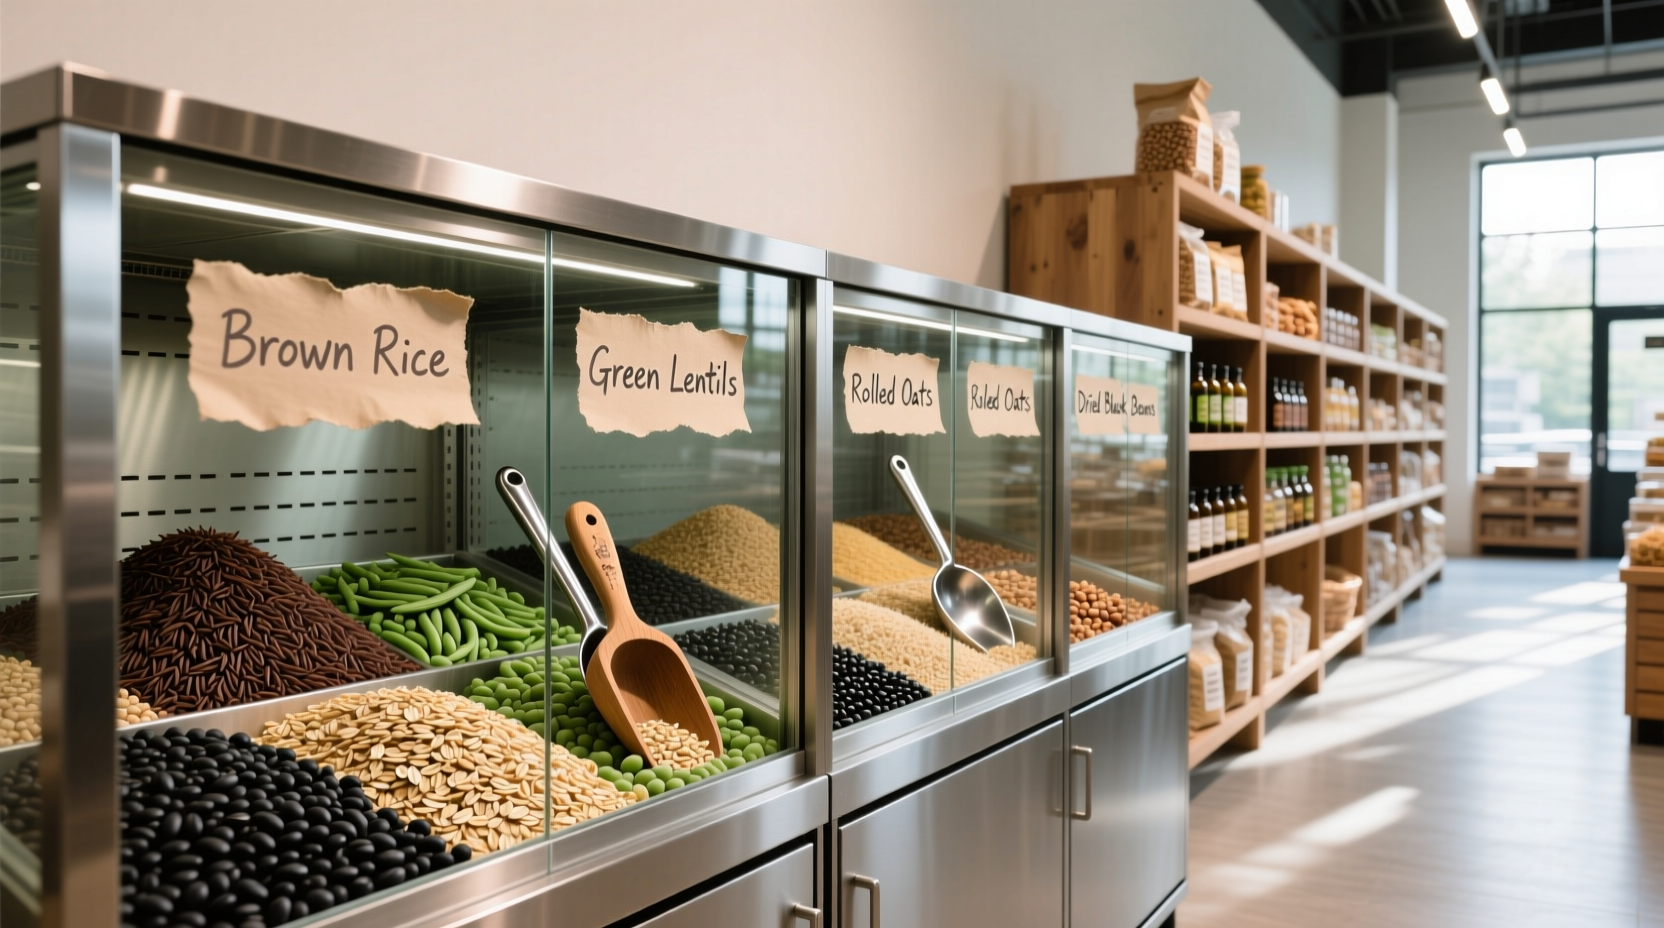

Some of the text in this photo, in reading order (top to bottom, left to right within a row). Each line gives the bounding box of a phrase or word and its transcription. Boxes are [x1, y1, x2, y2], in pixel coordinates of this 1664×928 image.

[221, 308, 450, 377] Brown Rice
[589, 345, 737, 396] Green Lentils
[852, 373, 933, 407] Rolled Oats
[1005, 387, 1031, 413] Oats
[1078, 390, 1101, 414] Dried
